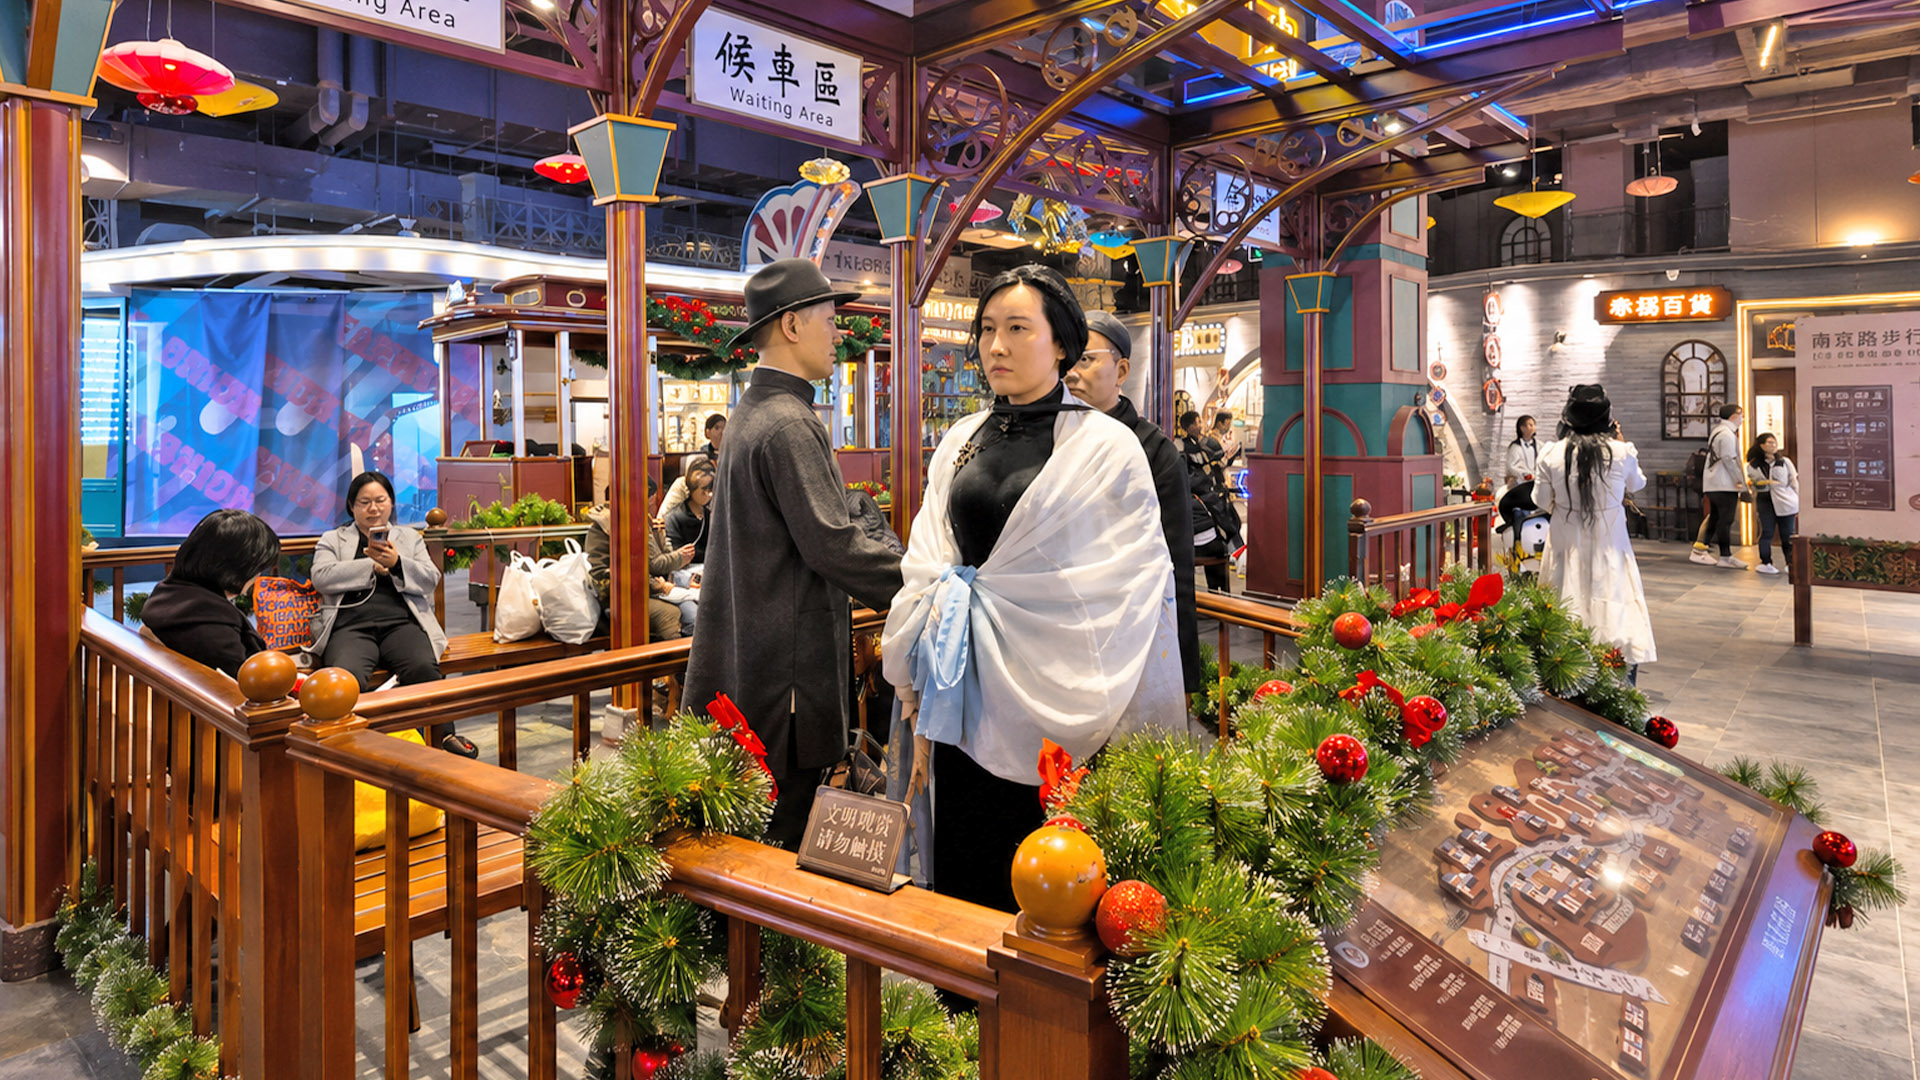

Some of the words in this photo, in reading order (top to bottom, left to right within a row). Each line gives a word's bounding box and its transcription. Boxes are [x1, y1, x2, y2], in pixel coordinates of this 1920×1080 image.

[400, 0, 455, 28] Area
[715, 31, 841, 106] 候車區
[730, 86, 793, 119] Waiting
[799, 106, 833, 127] Area
